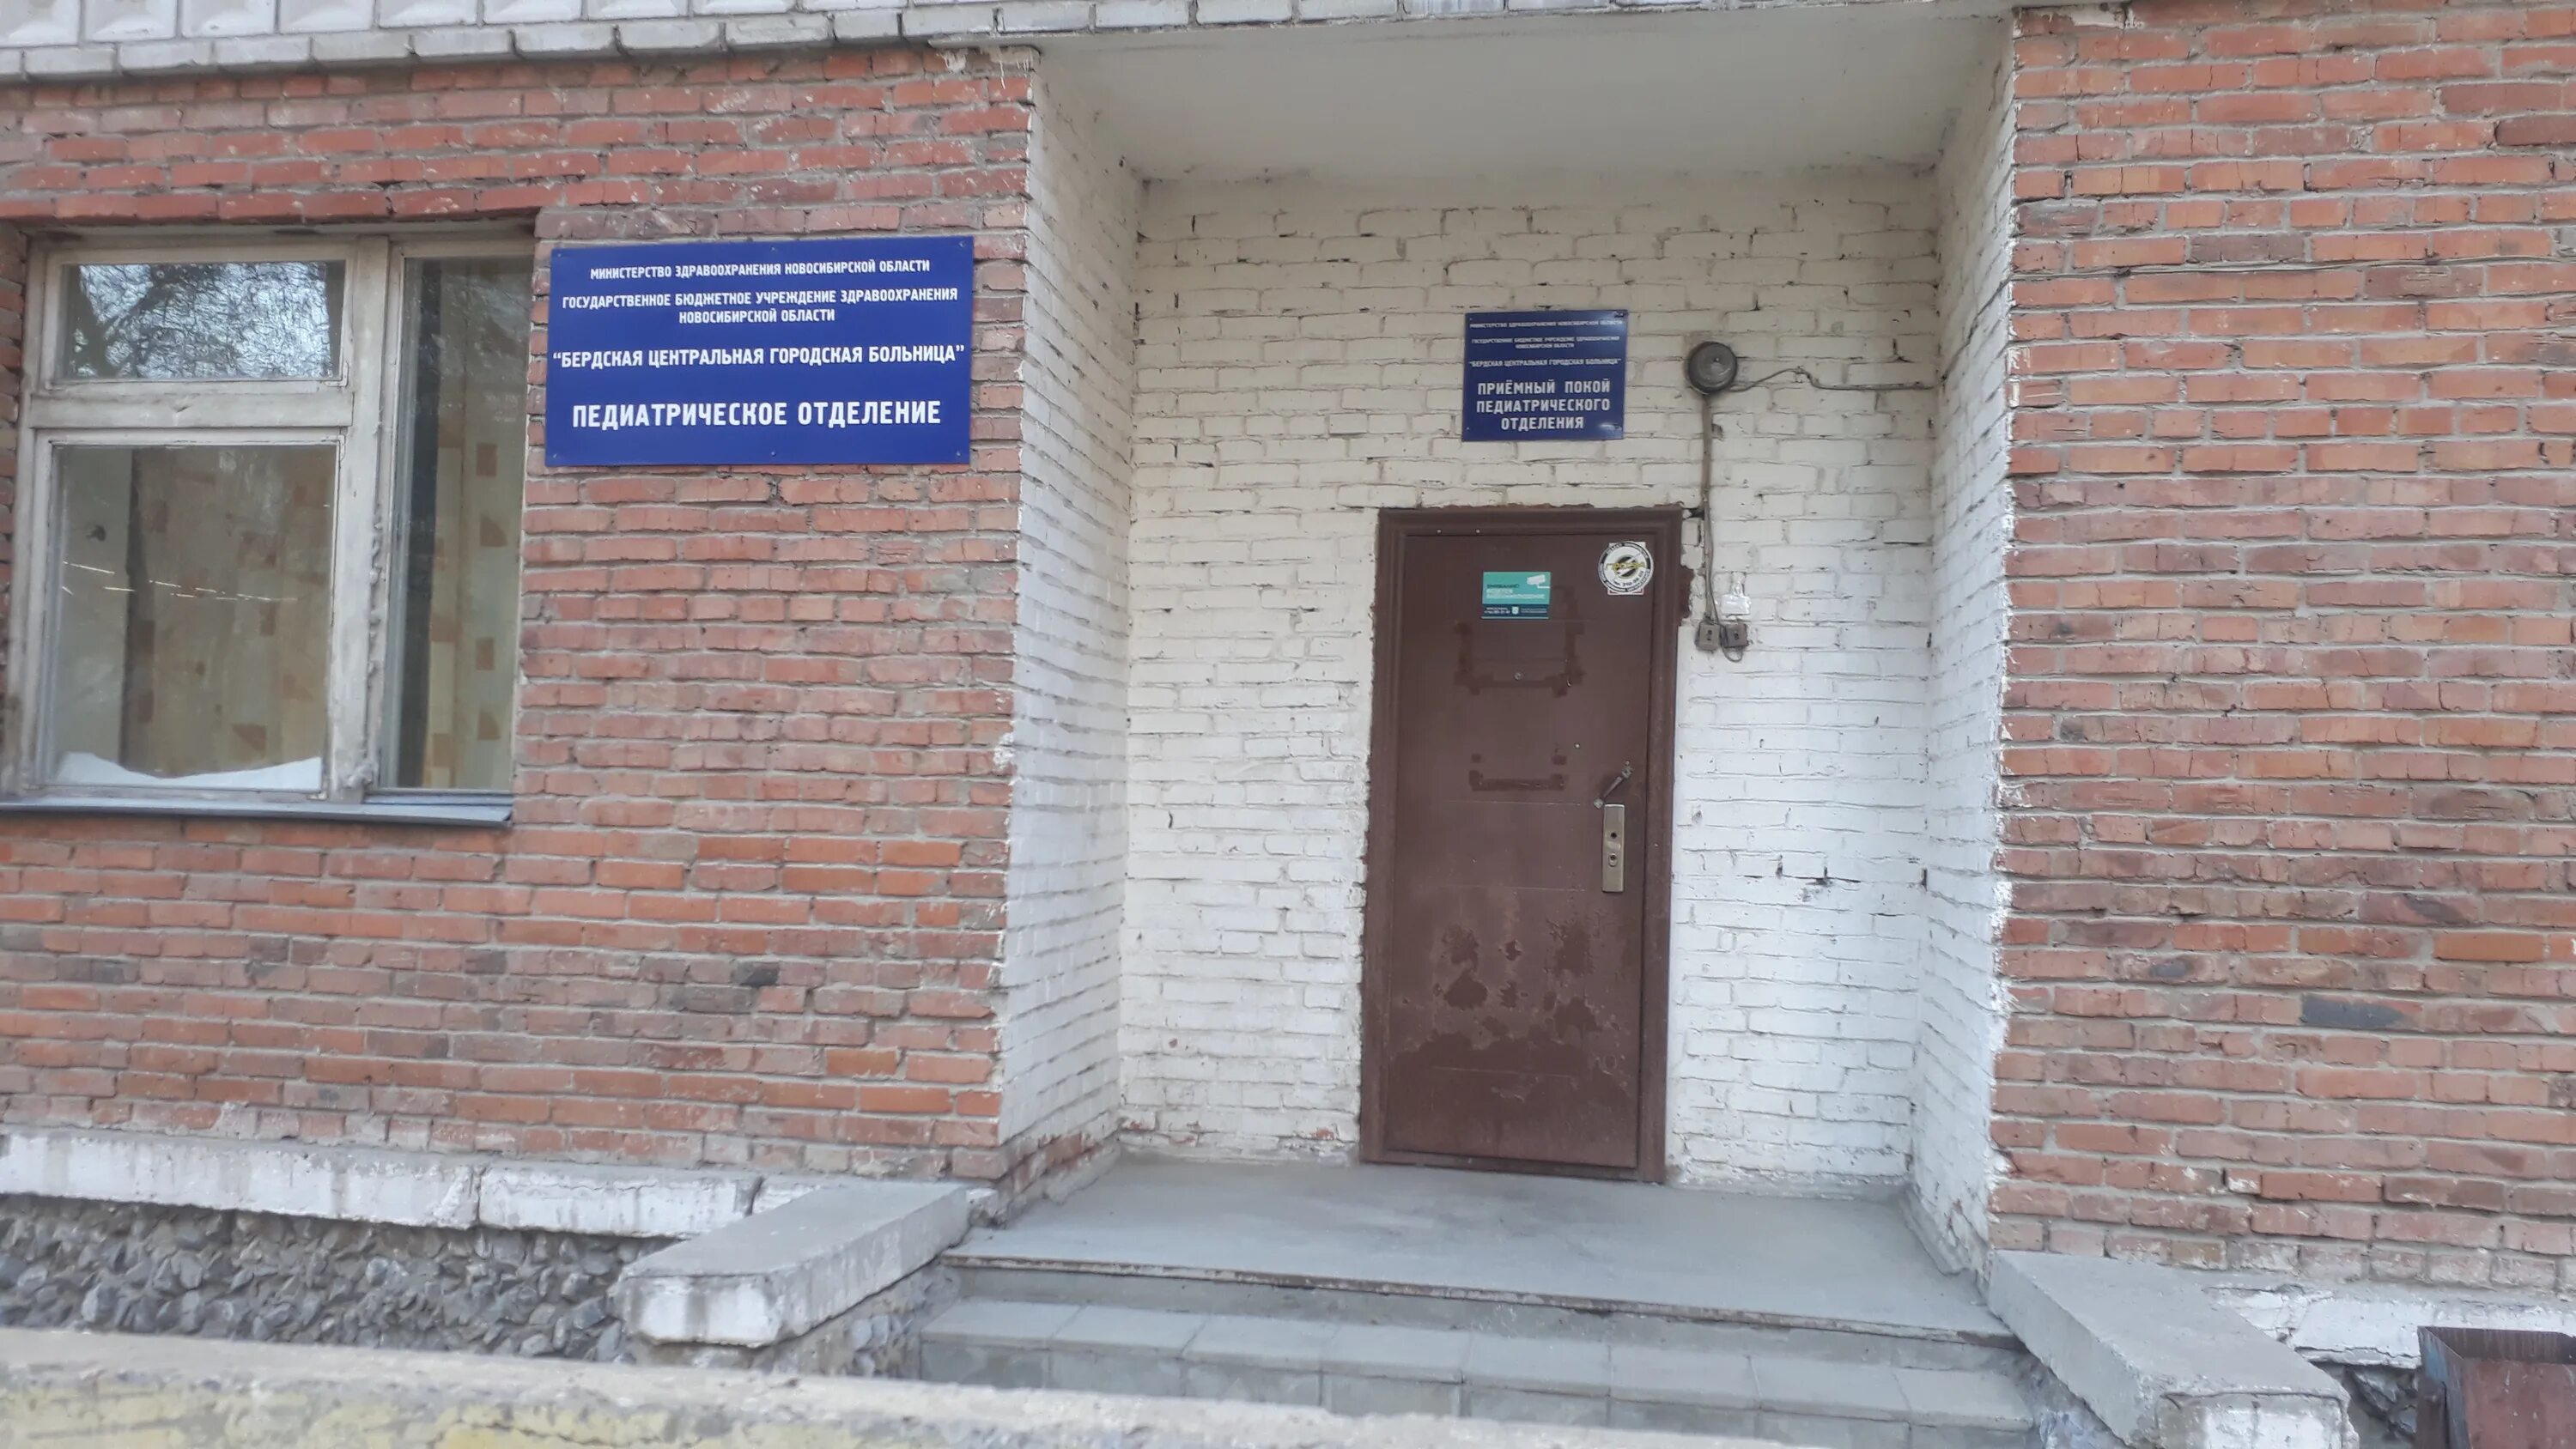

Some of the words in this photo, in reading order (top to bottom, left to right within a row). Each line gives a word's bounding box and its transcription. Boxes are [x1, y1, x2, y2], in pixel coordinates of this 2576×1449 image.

[591, 266, 671, 279] МИНИСТЕРСТВО
[676, 264, 781, 278] ЗДРАВООХРАНЕНИЯ
[785, 259, 875, 274] НОВОСИБИРСКОЙ
[879, 260, 929, 272] ОБЛАСТИ
[562, 294, 671, 309] ГОСУДАРСТВЕННОЕ
[676, 292, 751, 306] БЮДЖЕТНОЕ
[756, 290, 835, 305] УЧРЕЖДЕНИЕ
[841, 288, 957, 304] ЗДРАВООХРАНЕНИЯ
[679, 308, 776, 323] НОВОСИБИРСКОЙ
[781, 309, 835, 321] ОБЛАСТИ
[649, 349, 763, 367] ЦЕНТРАЛЬНАЯ
[770, 347, 862, 366] ГОРОДСКАЯ
[1478, 379, 1555, 395] ПРИЁМНЫЙ
[1565, 379, 1610, 393] ПОКОЙ
[1477, 398, 1610, 414] ПЕДИАТРИЧЕСКОГО
[574, 403, 787, 430] ПЕДИАТРИЧЕСКОЕ
[799, 401, 940, 427] ОТДЕЛЕНИЕ
[1502, 417, 1583, 431] ОТДЕЛЕНИЯ
